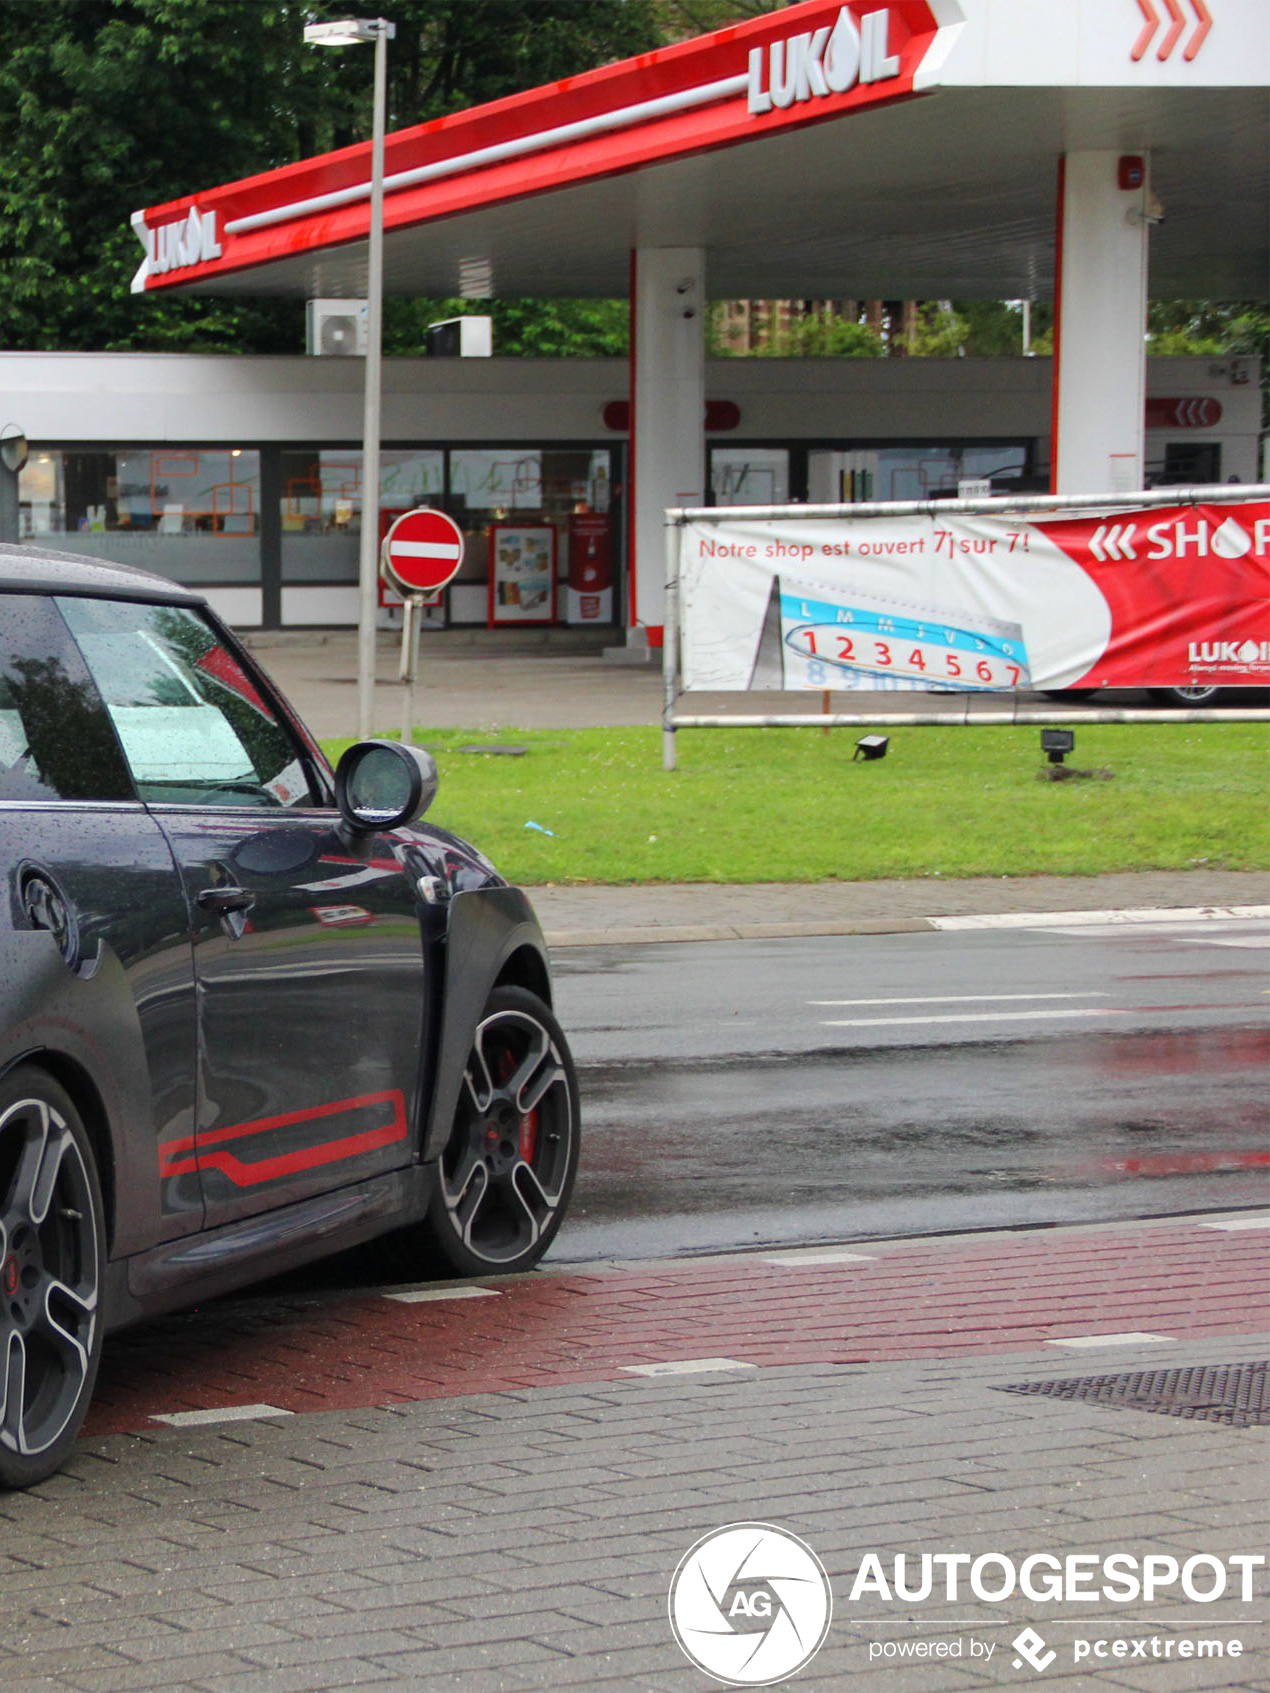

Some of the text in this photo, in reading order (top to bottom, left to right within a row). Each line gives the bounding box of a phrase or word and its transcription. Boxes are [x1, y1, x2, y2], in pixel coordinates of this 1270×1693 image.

[748, 5, 900, 114] LUKOIL
[147, 205, 222, 275] LUKOIL
[699, 531, 1030, 561] Notre shop est ouvert 7j sur 7!
[801, 602, 811, 617] L
[837, 609, 854, 624] M
[878, 618, 895, 632] M
[944, 630, 956, 644] V
[803, 631, 817, 654] 1
[836, 636, 856, 660] 2
[874, 642, 892, 666] 3
[909, 649, 926, 671] 4
[946, 655, 961, 676] 5
[976, 661, 992, 682] 6
[1005, 666, 1021, 687] 7
[1188, 639, 1270, 664] LUKOI
